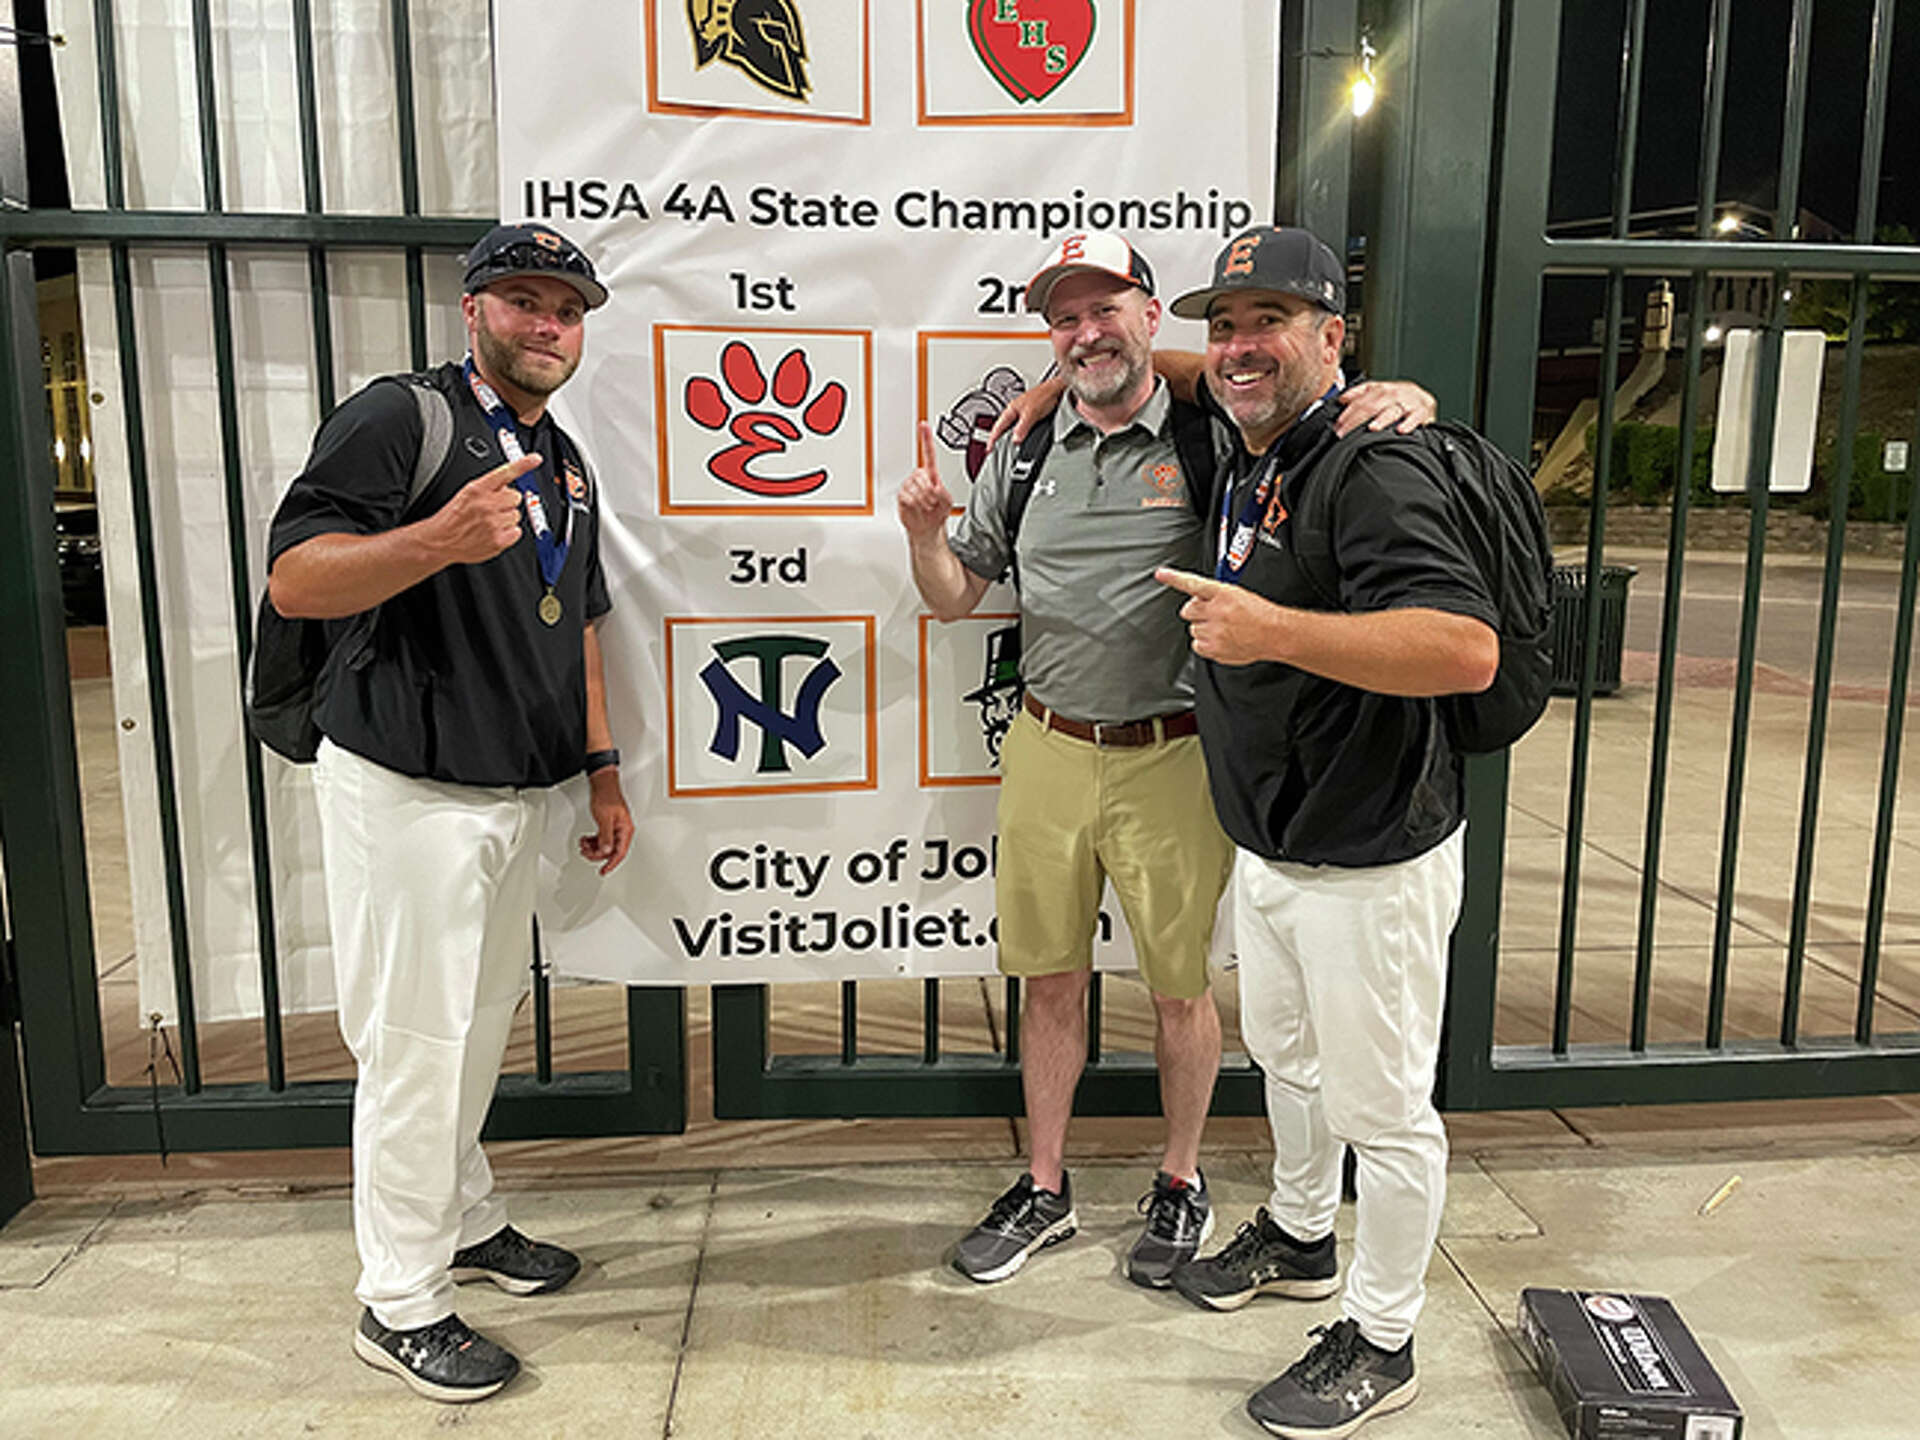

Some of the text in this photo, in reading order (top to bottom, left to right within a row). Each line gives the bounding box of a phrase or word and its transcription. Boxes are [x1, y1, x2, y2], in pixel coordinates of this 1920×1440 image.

[525, 180, 1251, 239] IHSA 4A State Championship
[1222, 235, 1261, 276] E
[730, 272, 795, 311] 1st
[977, 277, 1033, 314] 2n
[730, 547, 807, 584] 3rd
[710, 834, 999, 898] City of Jol
[672, 903, 1112, 958] VisitJoliet.
